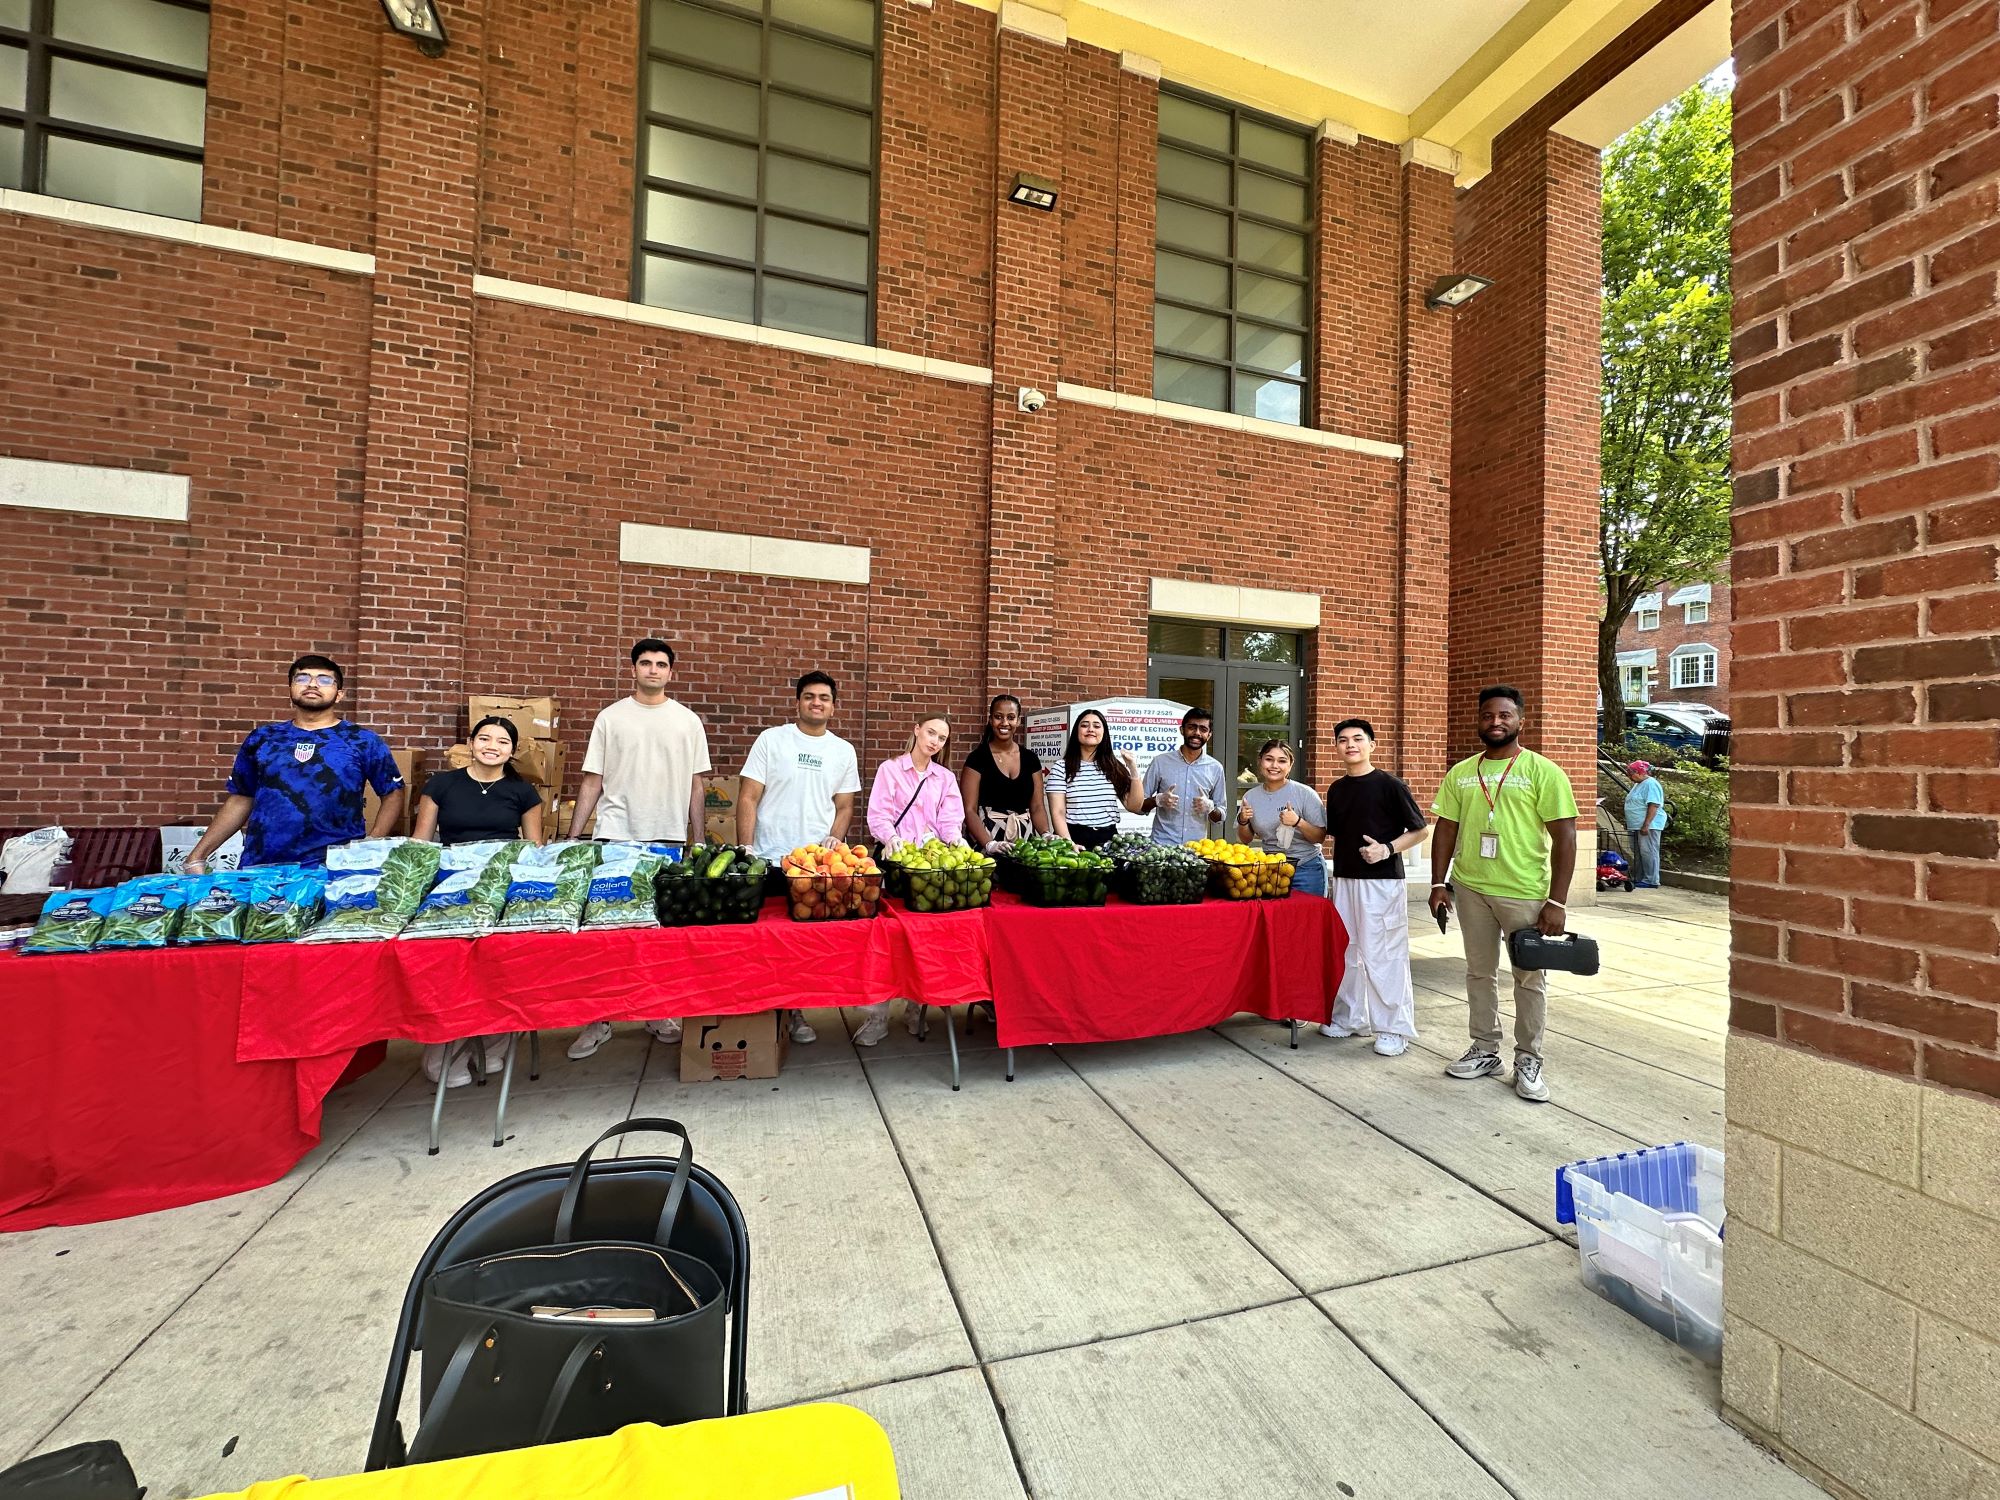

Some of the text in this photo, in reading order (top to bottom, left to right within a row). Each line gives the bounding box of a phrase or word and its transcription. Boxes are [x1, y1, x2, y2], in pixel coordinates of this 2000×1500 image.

[1112, 741, 1177, 752] ROP BOX
[1048, 748, 1061, 756] BOX
[593, 881, 628, 889] collard
